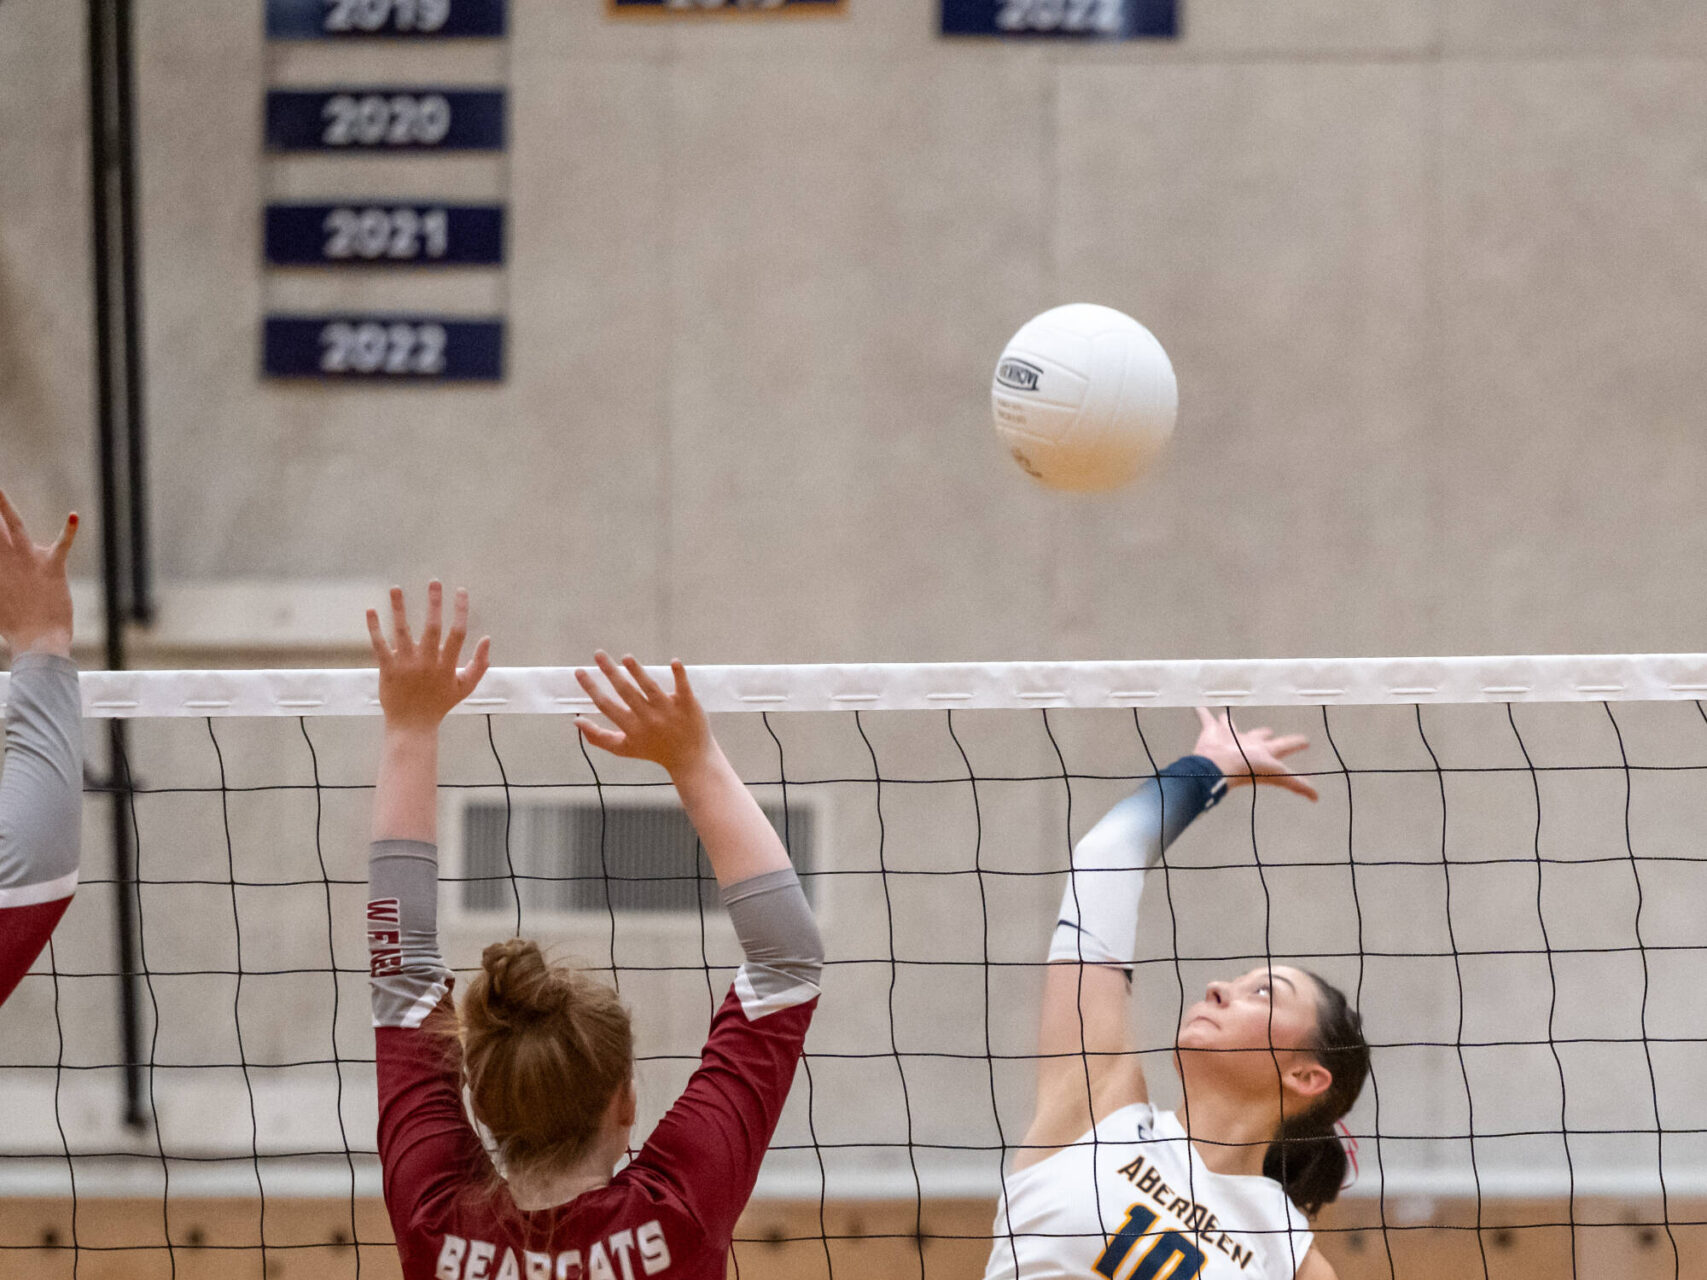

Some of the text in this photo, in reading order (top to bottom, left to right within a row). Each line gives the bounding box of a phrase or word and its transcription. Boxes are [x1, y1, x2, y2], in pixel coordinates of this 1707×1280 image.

[321, 94, 450, 145] 2020
[322, 208, 448, 259] 2021
[319, 322, 447, 374] 2022
[1116, 1154, 1254, 1270] ABERDEEN
